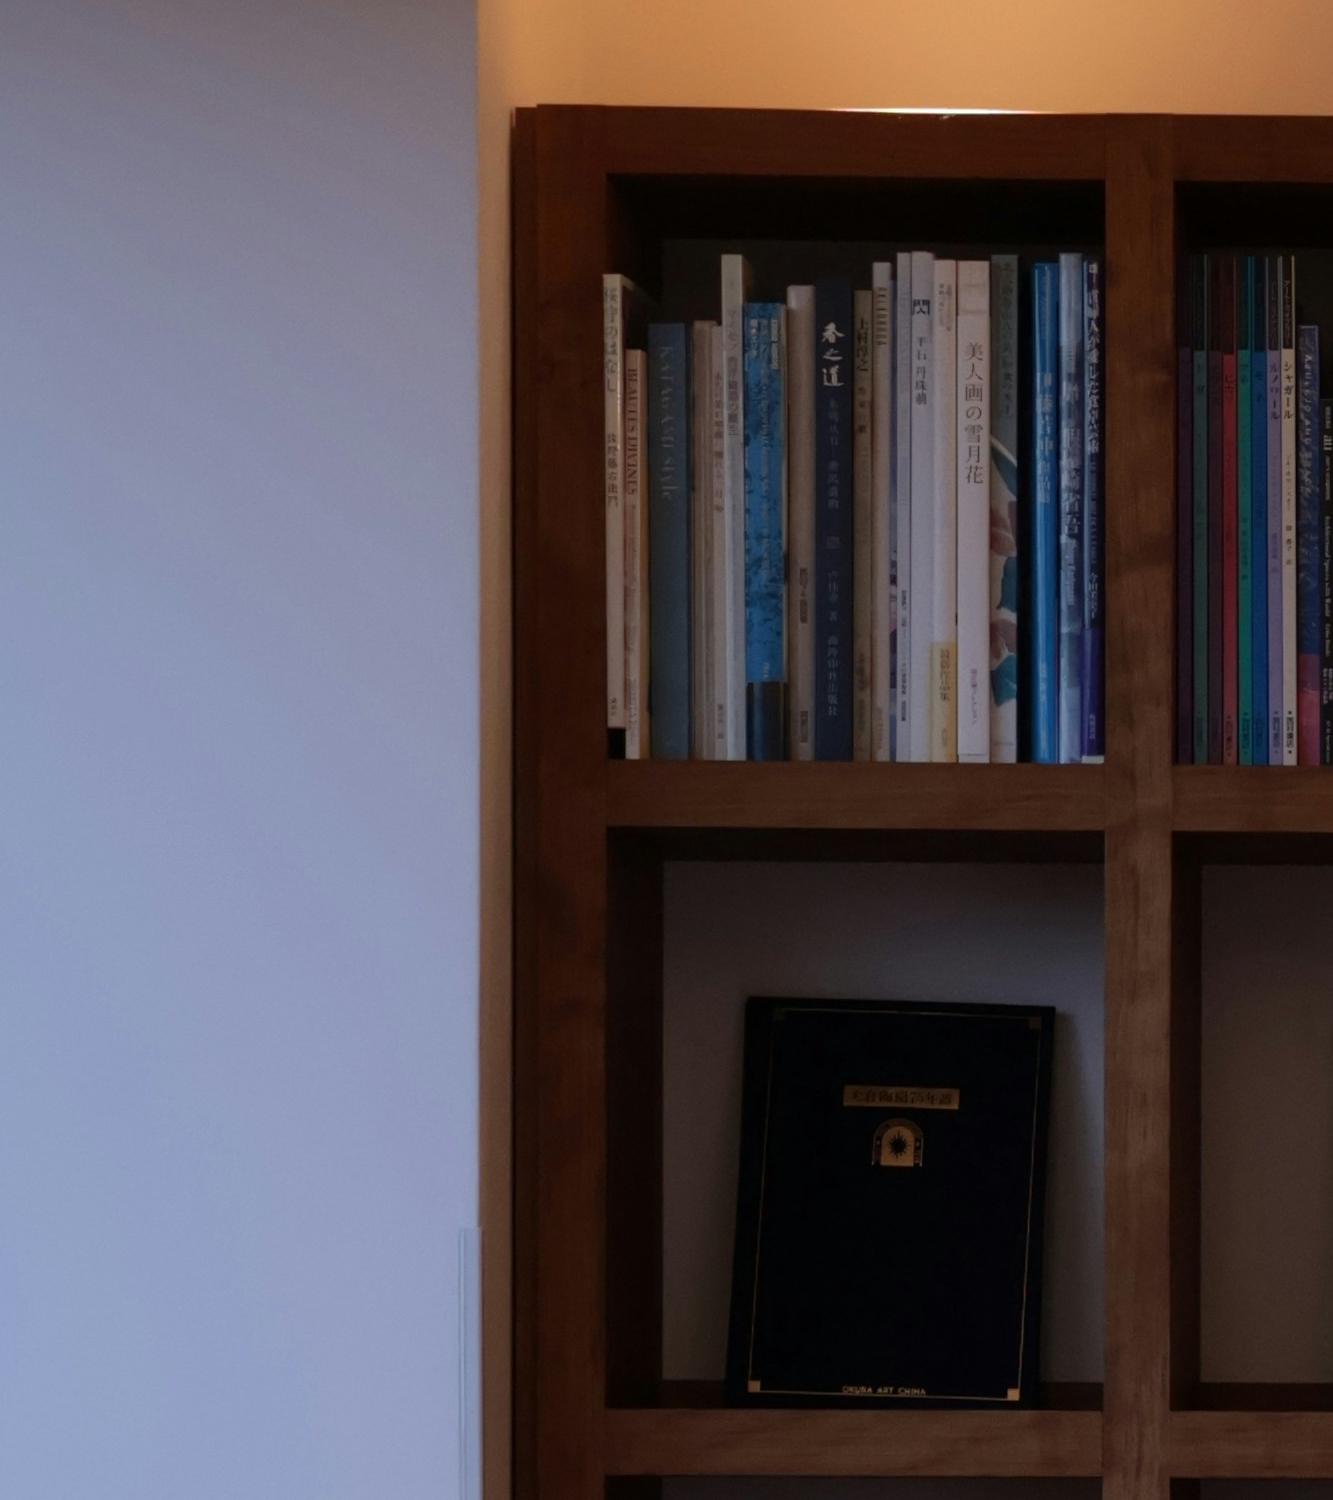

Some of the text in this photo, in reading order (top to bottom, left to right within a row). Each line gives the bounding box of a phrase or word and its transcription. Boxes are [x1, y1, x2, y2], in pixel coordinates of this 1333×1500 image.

[912, 299, 930, 316] 閃
[965, 341, 984, 485] 美人画の雪月花
[1283, 361, 1294, 419] シャガール
